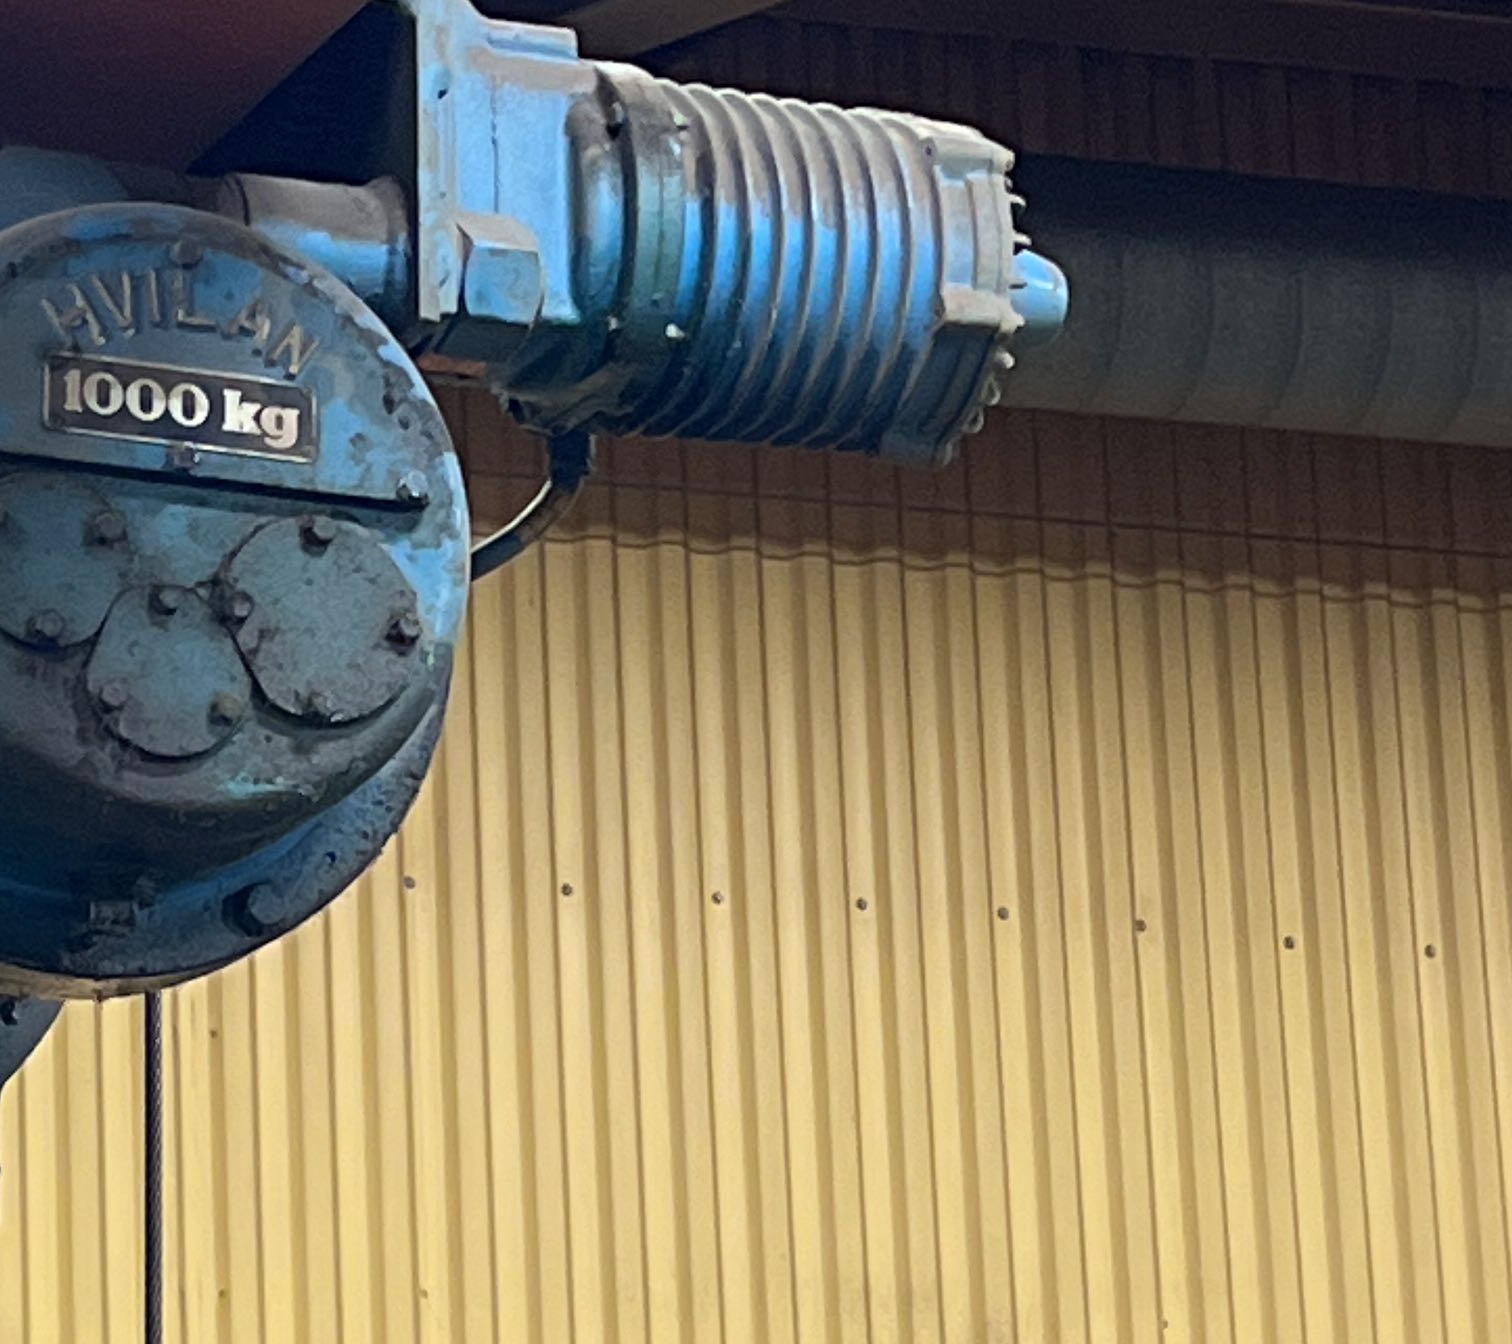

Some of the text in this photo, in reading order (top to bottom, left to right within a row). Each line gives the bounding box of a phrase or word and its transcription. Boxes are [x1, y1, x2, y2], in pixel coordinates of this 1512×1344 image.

[41, 268, 320, 378] HVILAN
[63, 368, 300, 449] 1000 kg
